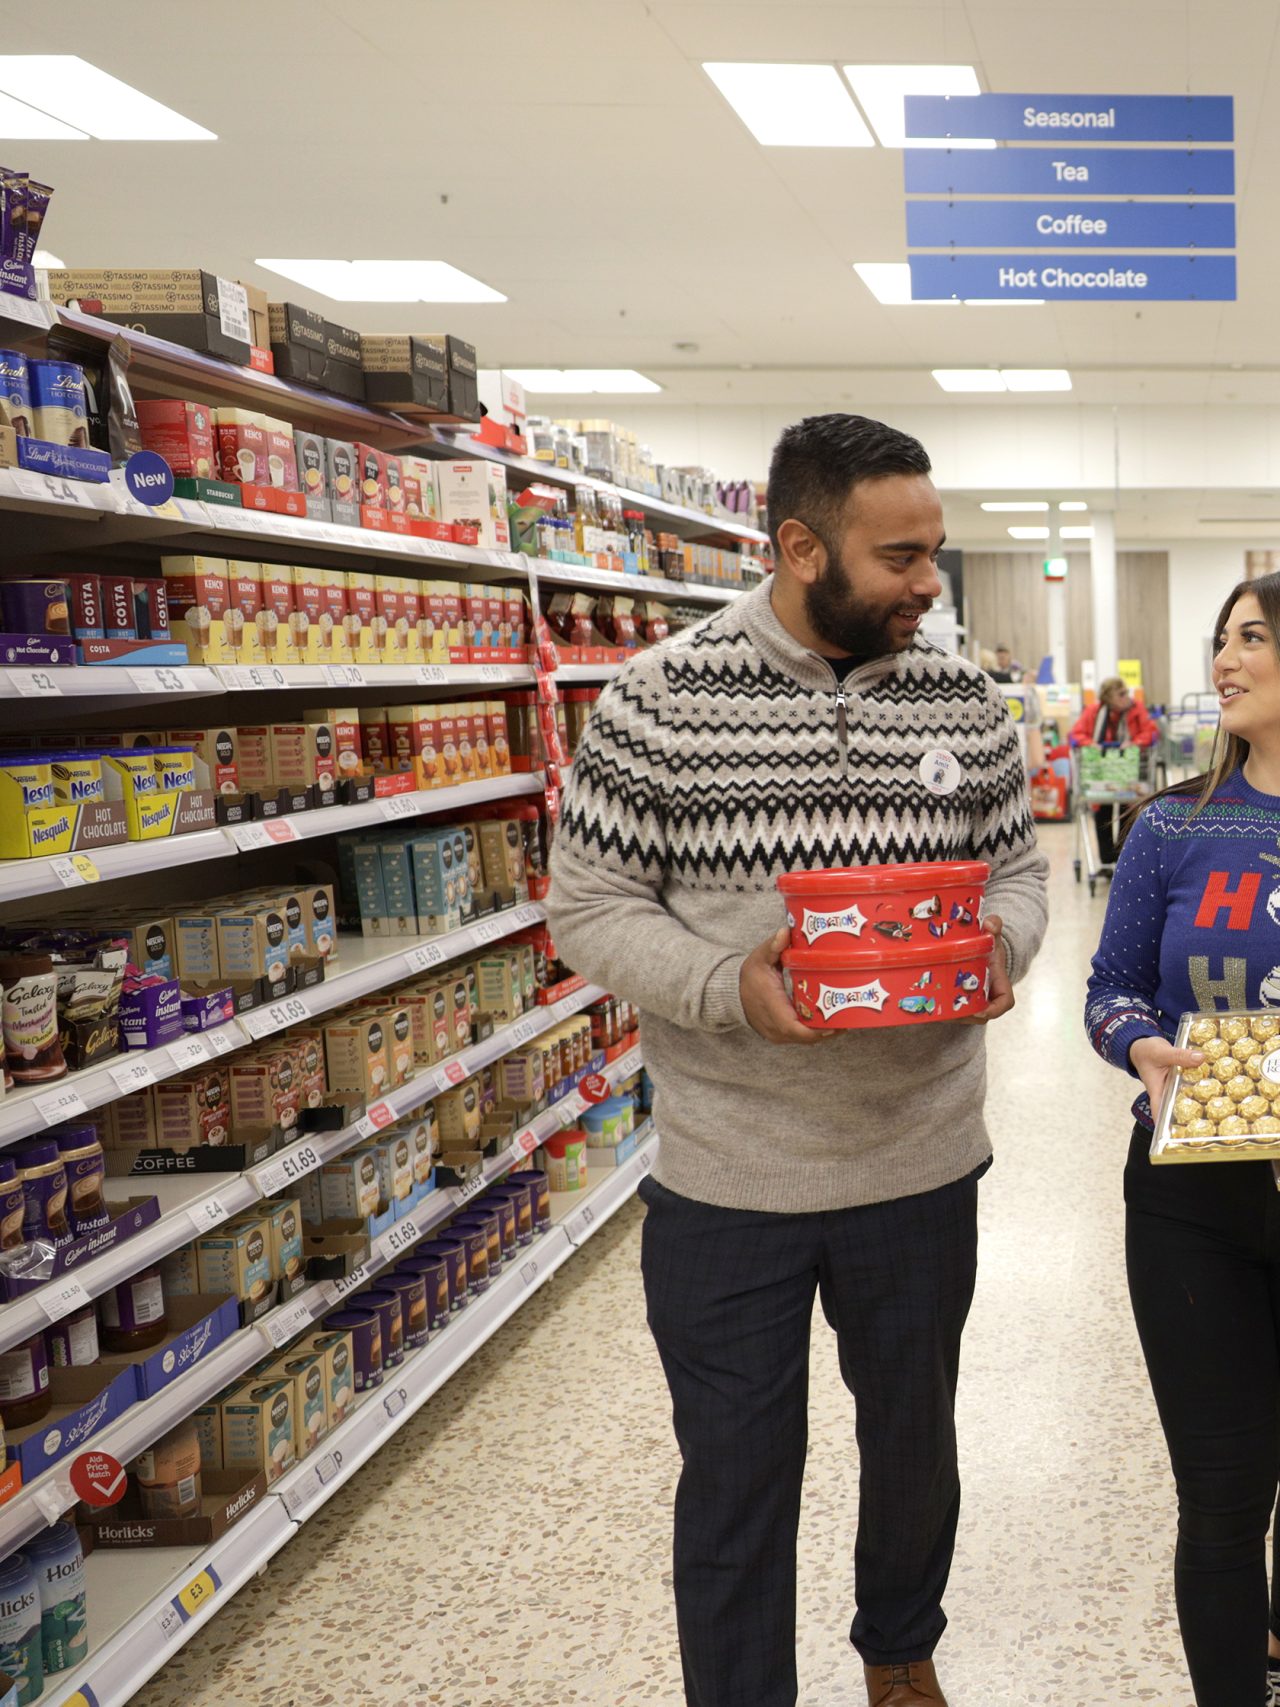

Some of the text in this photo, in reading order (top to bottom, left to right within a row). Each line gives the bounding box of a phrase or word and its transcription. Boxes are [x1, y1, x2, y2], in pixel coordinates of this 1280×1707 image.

[1023, 108, 1115, 128] Seasonal
[1052, 162, 1089, 182] Tea
[1036, 215, 1107, 234] Coffee
[999, 268, 1148, 288] Hot Chocolate
[300, 326, 324, 344] TASSIMO
[336, 343, 360, 360] TASSIMO
[422, 358, 444, 370] TASSIMO
[243, 429, 262, 441] KENCO
[272, 436, 290, 449] KENCO
[27, 446, 50, 463] Lindt
[45, 475, 78, 503] £4
[133, 472, 166, 489] New
[206, 488, 233, 500] STARBUCKS
[204, 579, 223, 590] KENCO
[238, 582, 256, 593] KENCO
[272, 584, 288, 596] KENCO
[303, 587, 319, 597] KENCO
[327, 589, 342, 599] KENCO
[82, 582, 96, 626] COSTA
[116, 584, 127, 627] COSTA
[158, 587, 167, 628] COSTA
[90, 645, 110, 654] COSTA
[31, 673, 56, 689] £2
[155, 669, 184, 690] £3
[336, 726, 354, 736] KENCO
[142, 795, 203, 828] Nesquik HOT
[180, 808, 214, 824] CHOCOLATE
[32, 808, 111, 845] Nesquik HOT
[83, 822, 127, 838] CHOCOLATE
[477, 923, 501, 940] £2.10
[416, 948, 442, 966] £1.69
[7, 984, 54, 1005] Galaxy
[72, 982, 110, 995] Galaxy
[156, 1000, 182, 1017] instant
[270, 1000, 306, 1025] £1.69
[86, 1027, 118, 1054] Galaxy
[213, 1035, 226, 1045] 35p
[187, 1044, 203, 1056] 32p
[131, 1065, 148, 1080] 32p
[58, 1094, 79, 1107] £2.85
[133, 1157, 195, 1170] COFFEE
[282, 1148, 318, 1179] £1.69
[206, 1201, 223, 1219] £4
[581, 1208, 595, 1224] £3
[87, 1226, 117, 1249] instant
[388, 1222, 417, 1250] £1.69
[61, 1285, 80, 1300] £2.50
[86, 1462, 109, 1472] Price
[89, 1455, 103, 1463] Aldi
[87, 1470, 111, 1480] Match
[226, 1487, 256, 1519] Horlicks
[98, 1525, 154, 1540] Horlicks
[191, 1583, 204, 1600] £3
